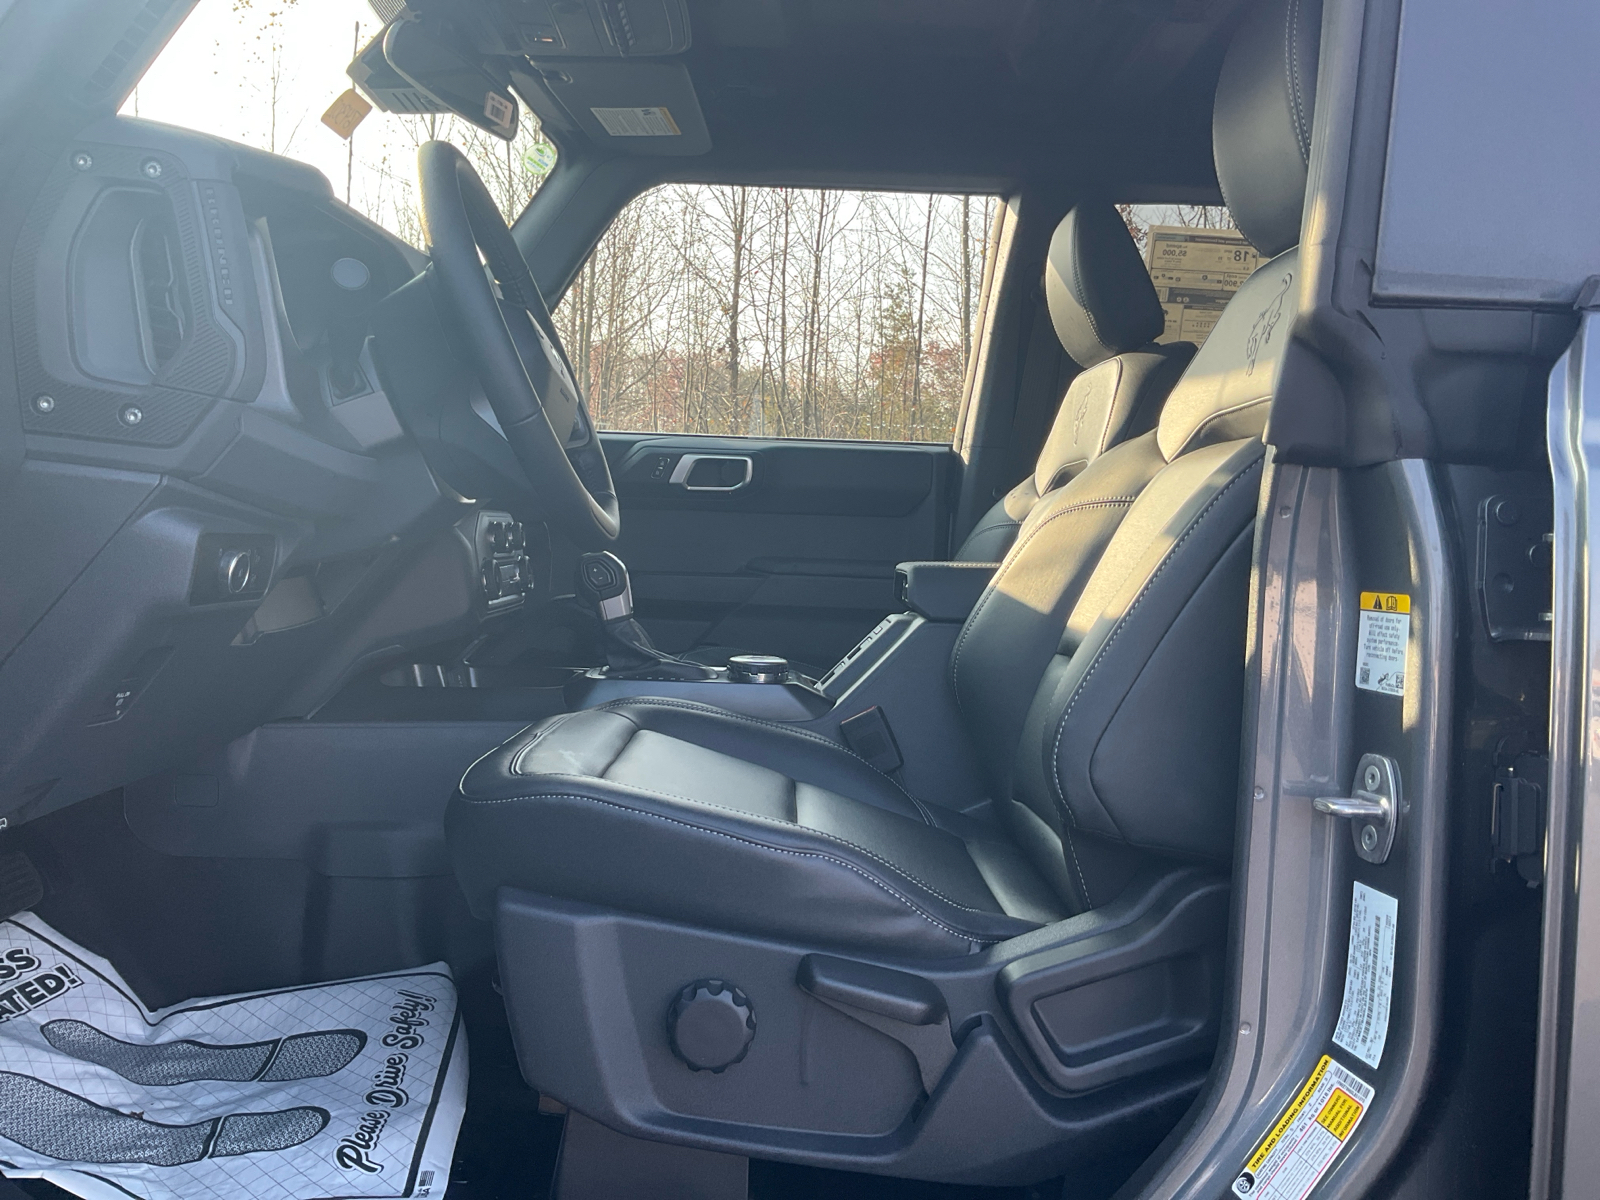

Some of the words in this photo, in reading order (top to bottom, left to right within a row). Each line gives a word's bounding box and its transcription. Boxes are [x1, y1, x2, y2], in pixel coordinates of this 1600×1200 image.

[205, 187, 234, 305] BRONCO
[335, 1110, 387, 1174] Please
[365, 1054, 406, 1108] Drive
[1252, 1153, 1265, 1168] TIRE
[1265, 1138, 1276, 1152] AND
[1275, 1108, 1298, 1137] LOADING
[1297, 1059, 1328, 1107] INFORMATION
[1327, 1109, 1340, 1128] MANUAL
[1334, 1105, 1352, 1132] ADDITIONAL
[1339, 1106, 1360, 1137] INFORMATION
